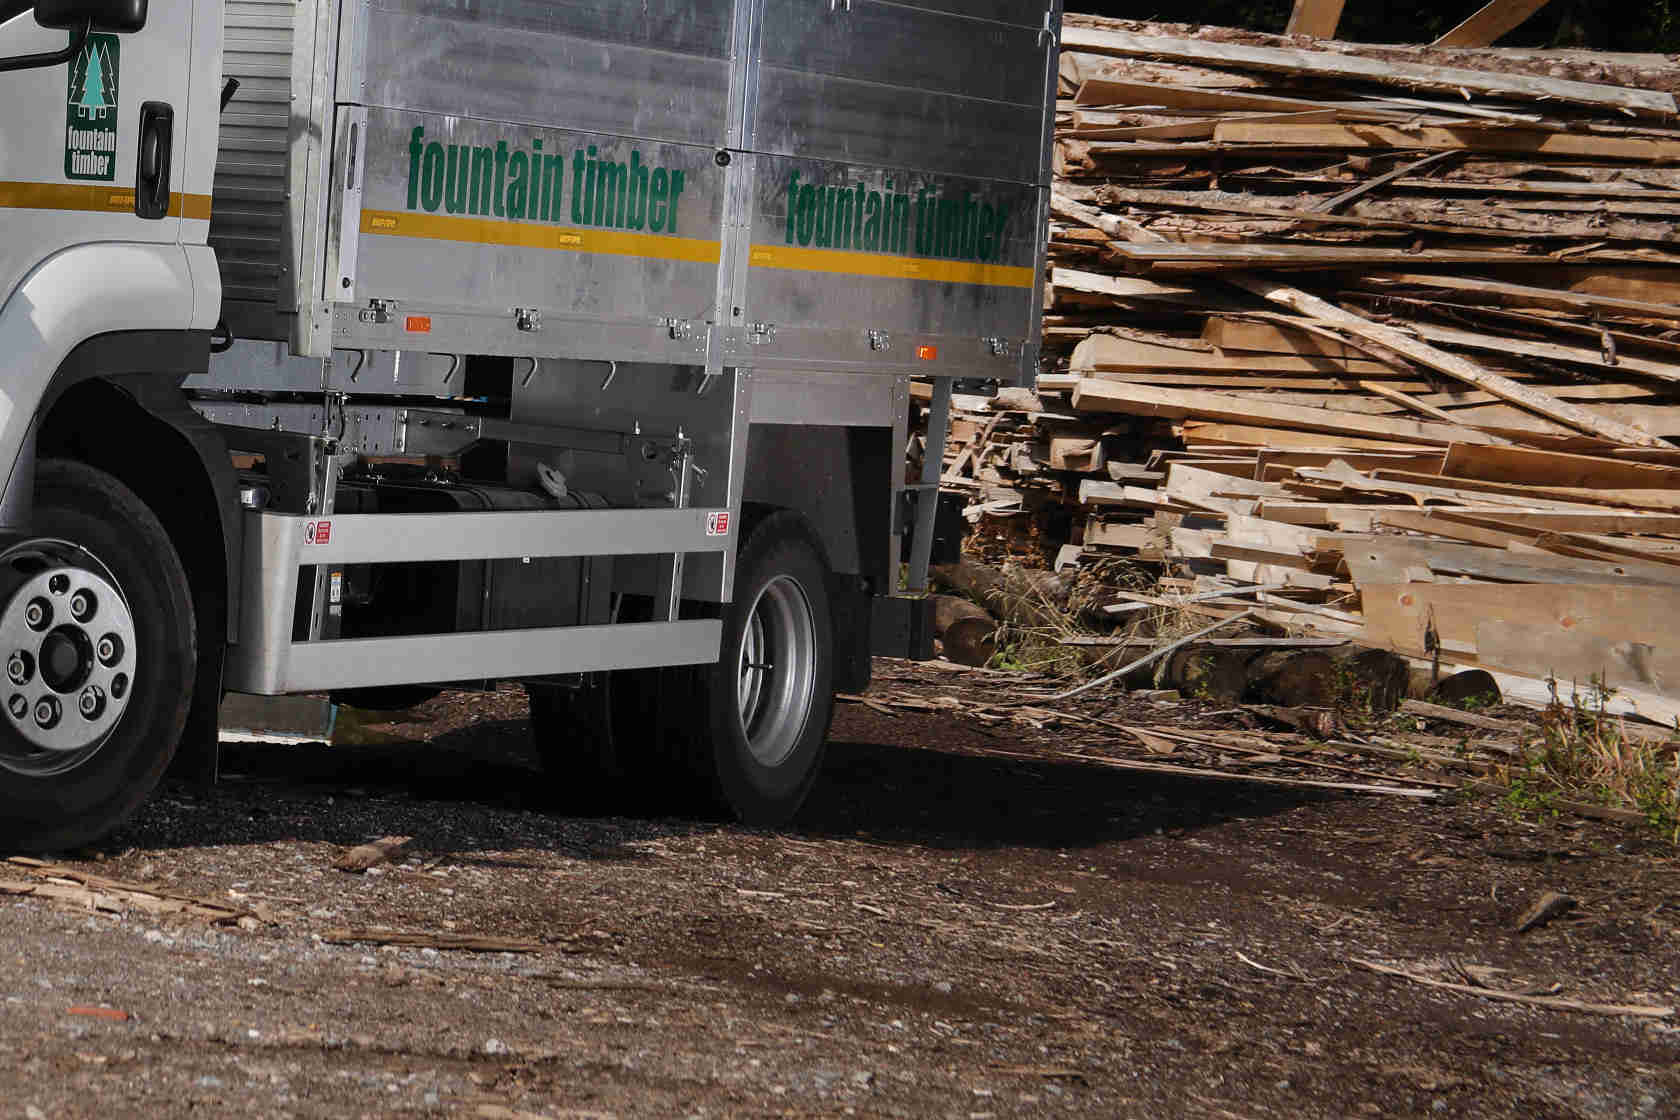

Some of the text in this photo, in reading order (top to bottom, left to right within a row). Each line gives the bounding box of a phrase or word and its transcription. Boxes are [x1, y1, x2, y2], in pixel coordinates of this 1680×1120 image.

[67, 126, 116, 151] fountain
[71, 150, 110, 176] timber
[406, 126, 685, 234] fountain timber
[785, 170, 1009, 262] fountain timber
